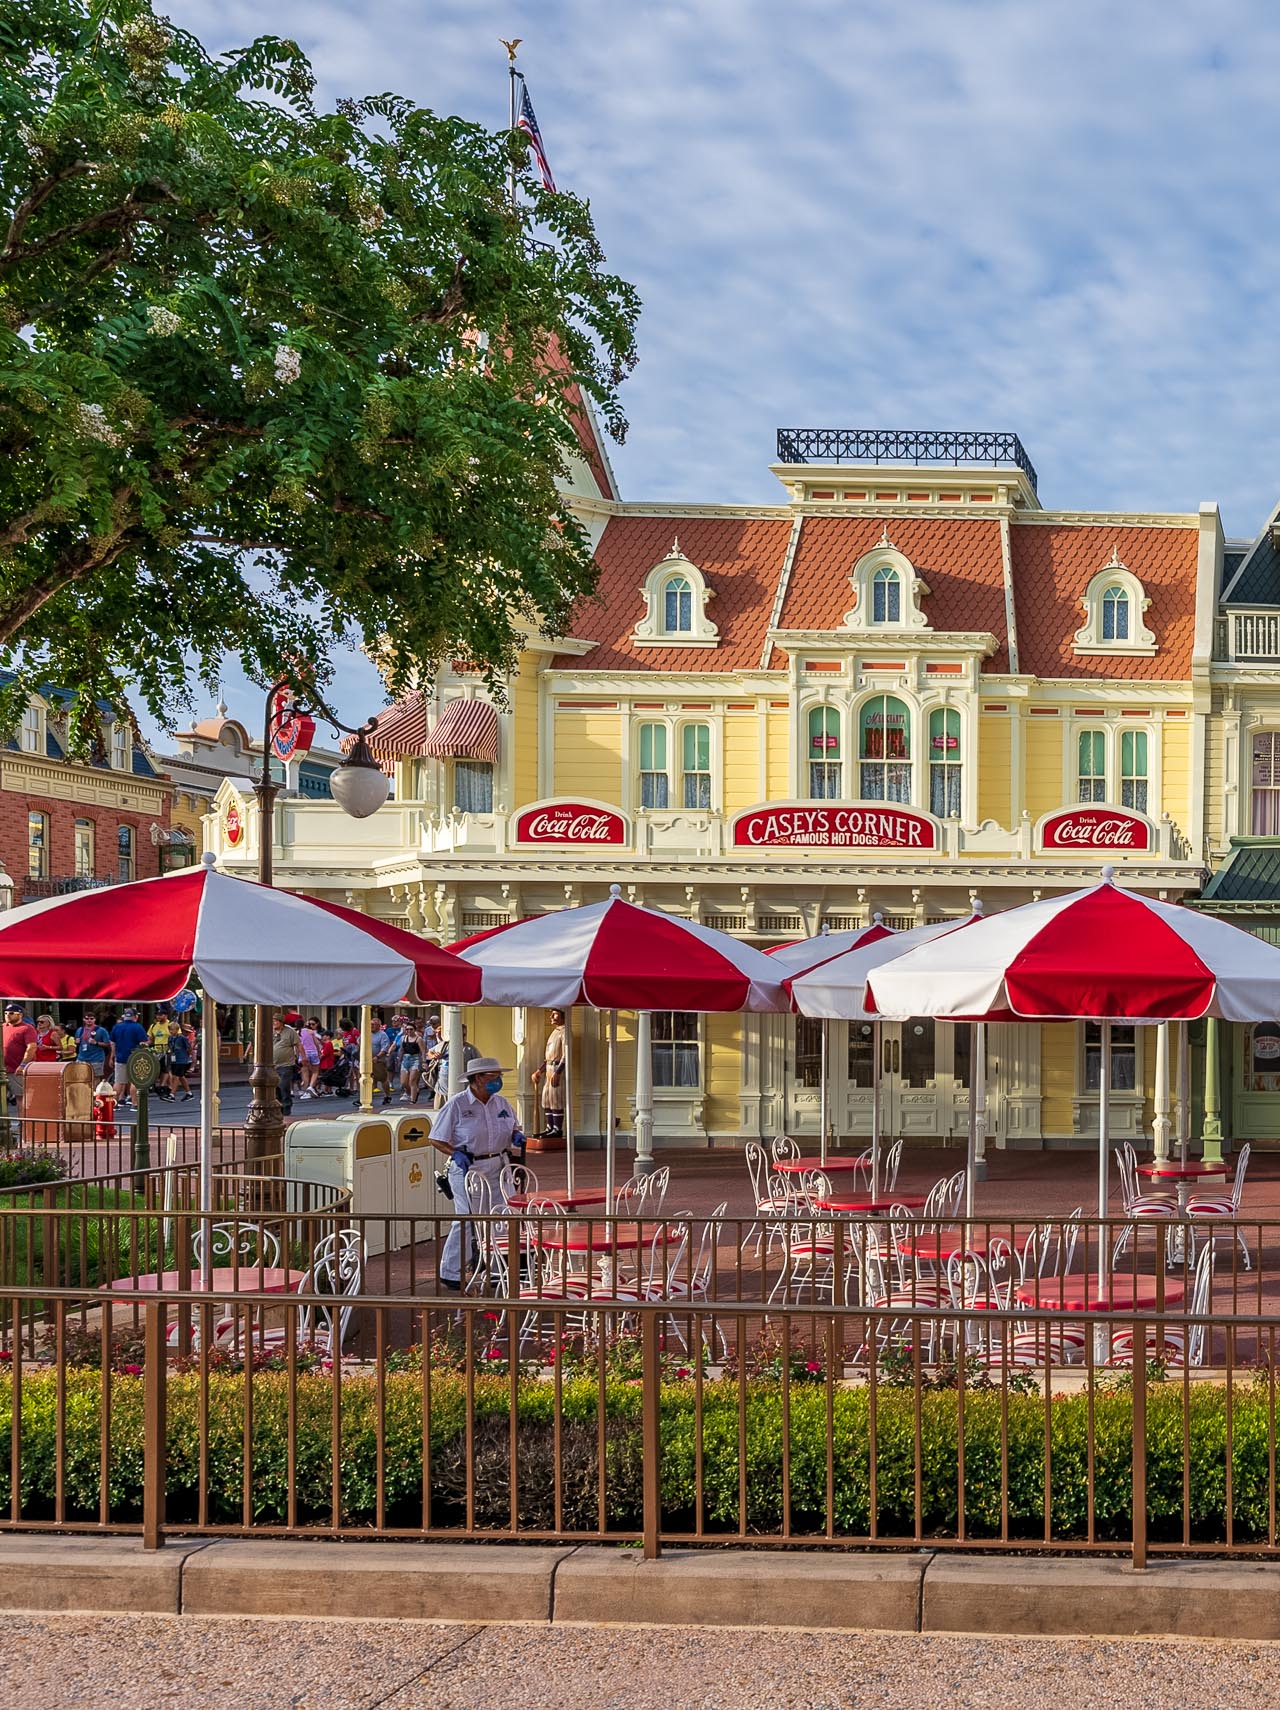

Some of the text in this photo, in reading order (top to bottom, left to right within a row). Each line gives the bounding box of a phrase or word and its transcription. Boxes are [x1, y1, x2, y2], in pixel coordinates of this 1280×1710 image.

[528, 813, 612, 839] Coca-Cola
[747, 809, 922, 846] CASEY'S CORNER
[790, 832, 879, 846] FAMOUS HOT DOGS
[1053, 819, 1136, 845] Coca-Cola
